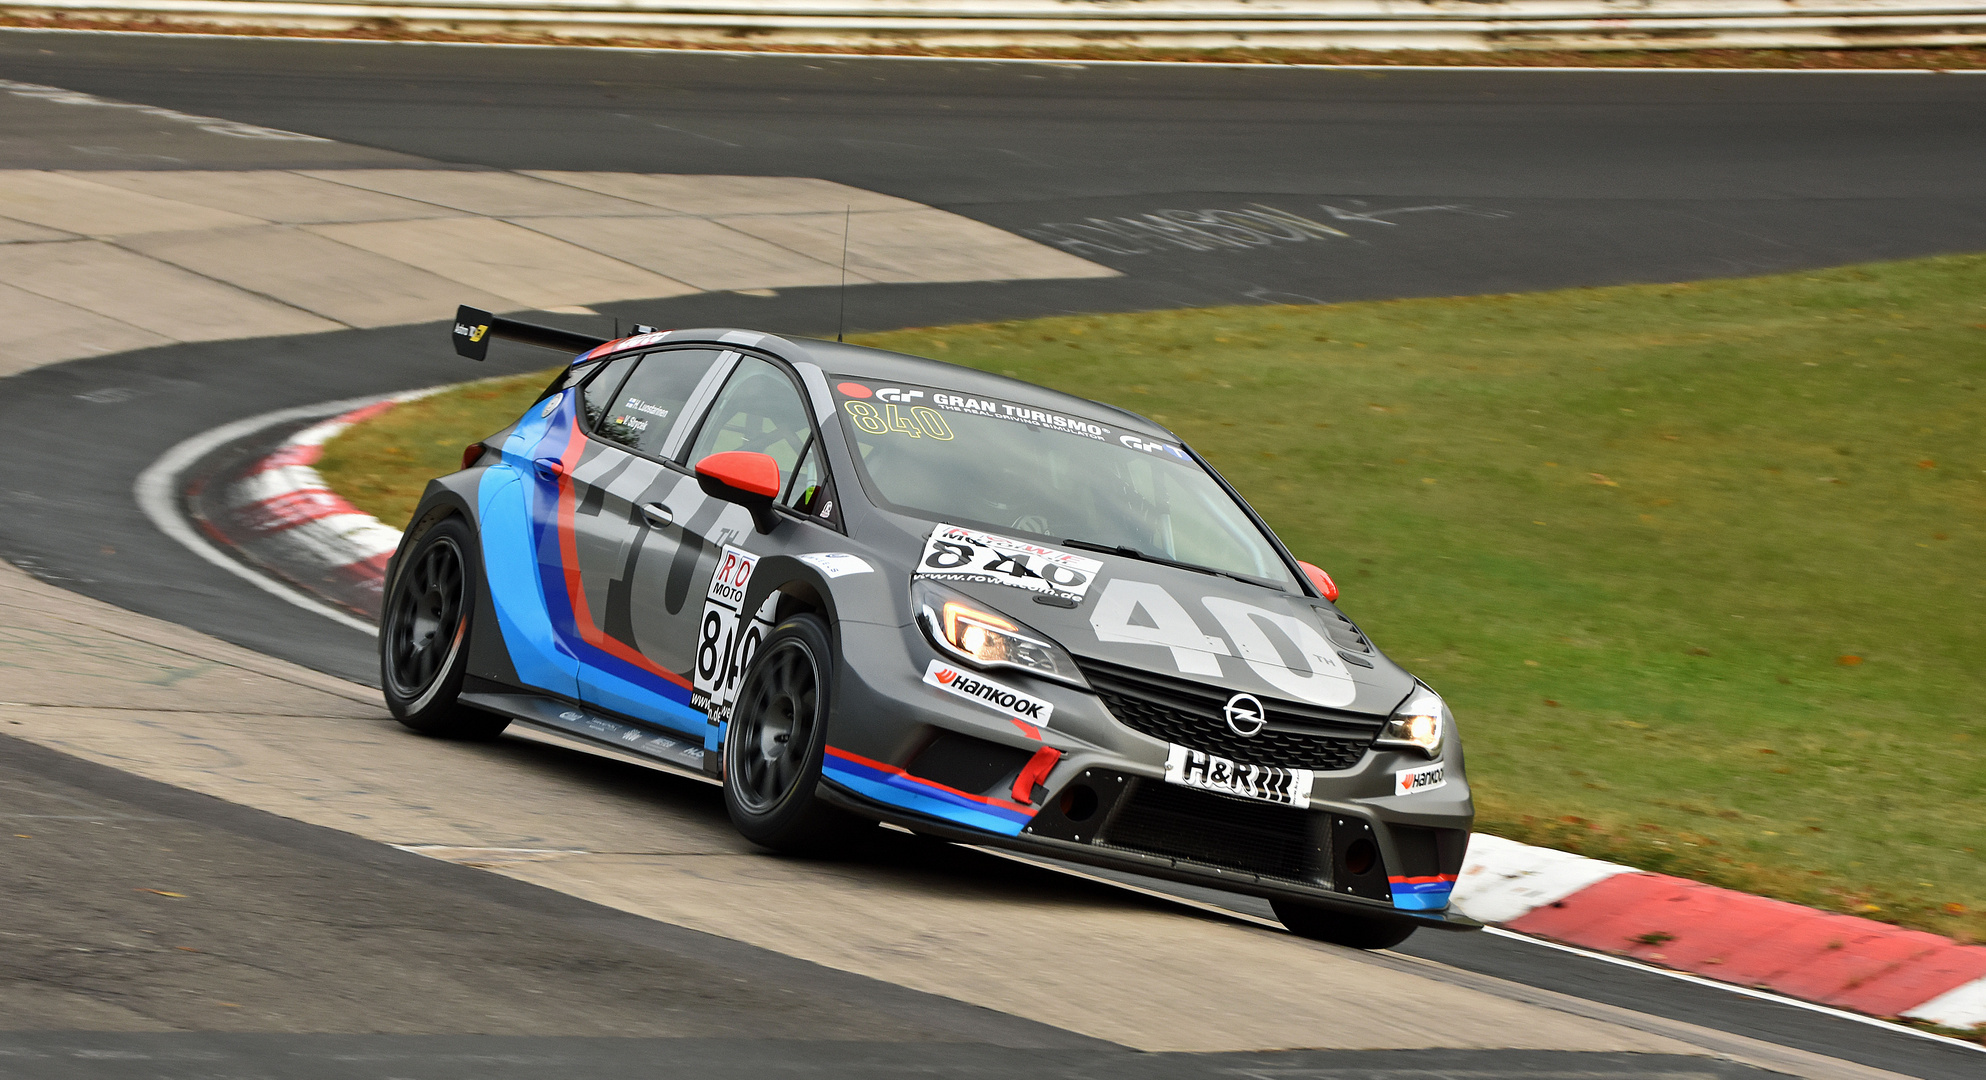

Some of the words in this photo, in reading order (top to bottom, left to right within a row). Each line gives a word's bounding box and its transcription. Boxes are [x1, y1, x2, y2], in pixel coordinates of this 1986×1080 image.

[844, 400, 955, 441] 840
[933, 393, 996, 414] GRAN
[938, 404, 955, 413] THE
[957, 407, 993, 418] REAL
[994, 413, 1041, 427] DRIVING
[1042, 422, 1106, 442] SIMULATOR
[712, 582, 743, 603] MOTO
[1089, 577, 1357, 708] 40
[1312, 653, 1336, 668] TH
[1184, 749, 1252, 793] H&R
